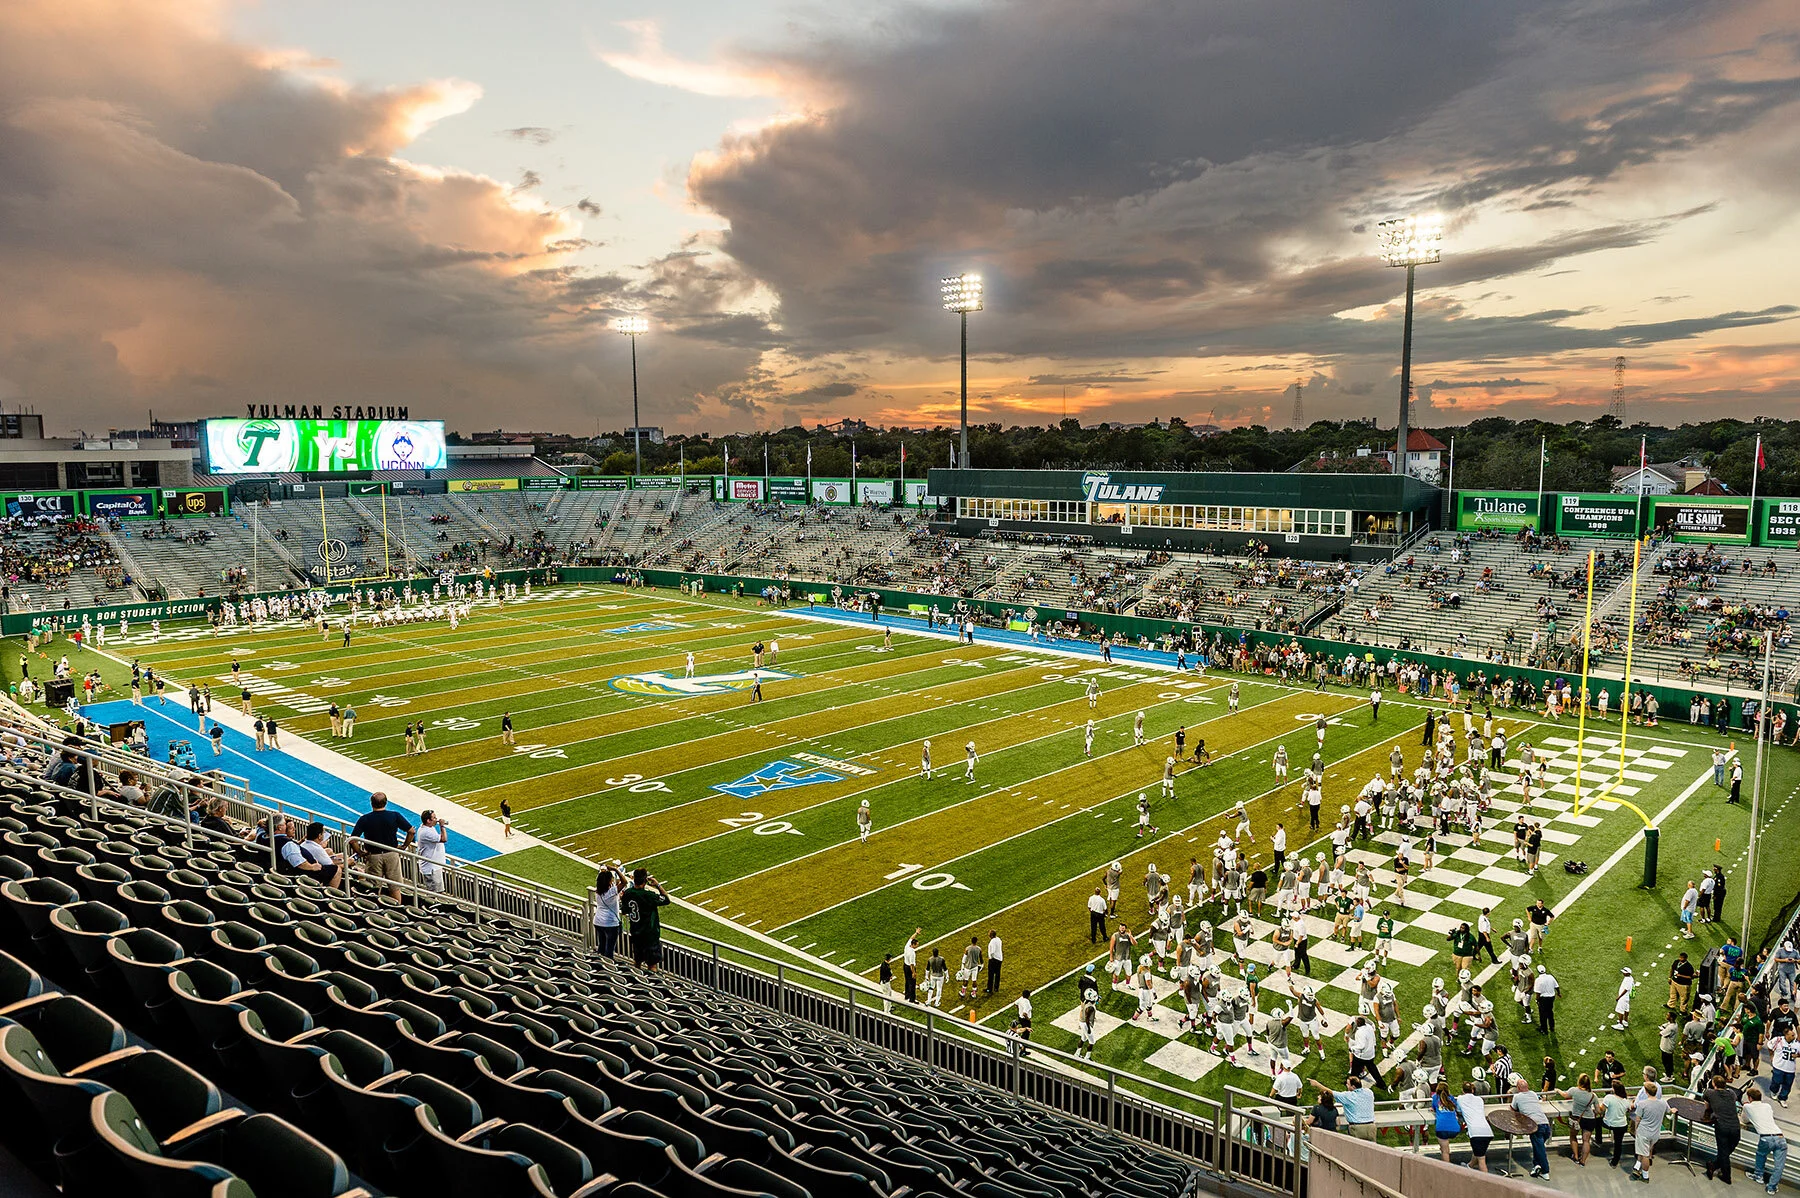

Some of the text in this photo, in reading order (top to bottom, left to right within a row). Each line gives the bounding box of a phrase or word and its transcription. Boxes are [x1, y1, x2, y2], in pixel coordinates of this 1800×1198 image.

[247, 404, 409, 419] YULMAN STADIUM
[381, 459, 425, 469] UCONN
[1084, 475, 1163, 501] TULANE
[188, 499, 204, 508] ups
[1474, 498, 1526, 513] Tulane
[1564, 507, 1617, 515] CONFERENCE
[1574, 514, 1623, 522] CHAMPIONS
[1677, 513, 1724, 525] OLE SAINT
[310, 564, 357, 577] Allstate
[97, 612, 117, 621] BOH
[120, 606, 163, 618] STUDENT
[166, 603, 205, 615] SECTION
[432, 717, 481, 731] 50
[512, 743, 566, 759] 40
[605, 774, 666, 793] 30
[718, 812, 793, 835] 20
[884, 863, 956, 890] 10
[629, 900, 640, 922] 3
